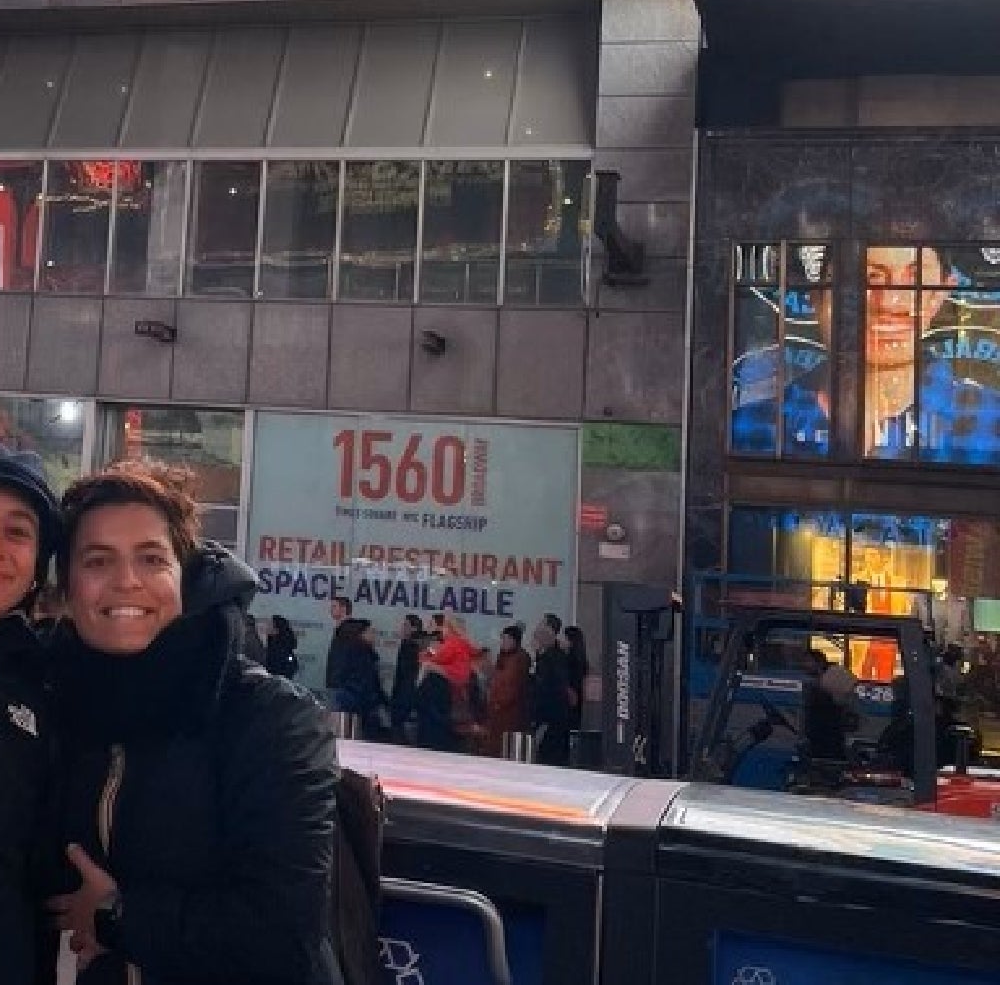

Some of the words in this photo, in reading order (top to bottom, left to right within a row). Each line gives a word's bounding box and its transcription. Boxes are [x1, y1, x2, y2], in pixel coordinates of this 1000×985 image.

[333, 429, 466, 507] 1560
[421, 514, 488, 532] FLAGSHIP
[259, 535, 349, 564] RETAIL
[259, 568, 347, 601] SPACE
[354, 578, 514, 619] AVAILABLE
